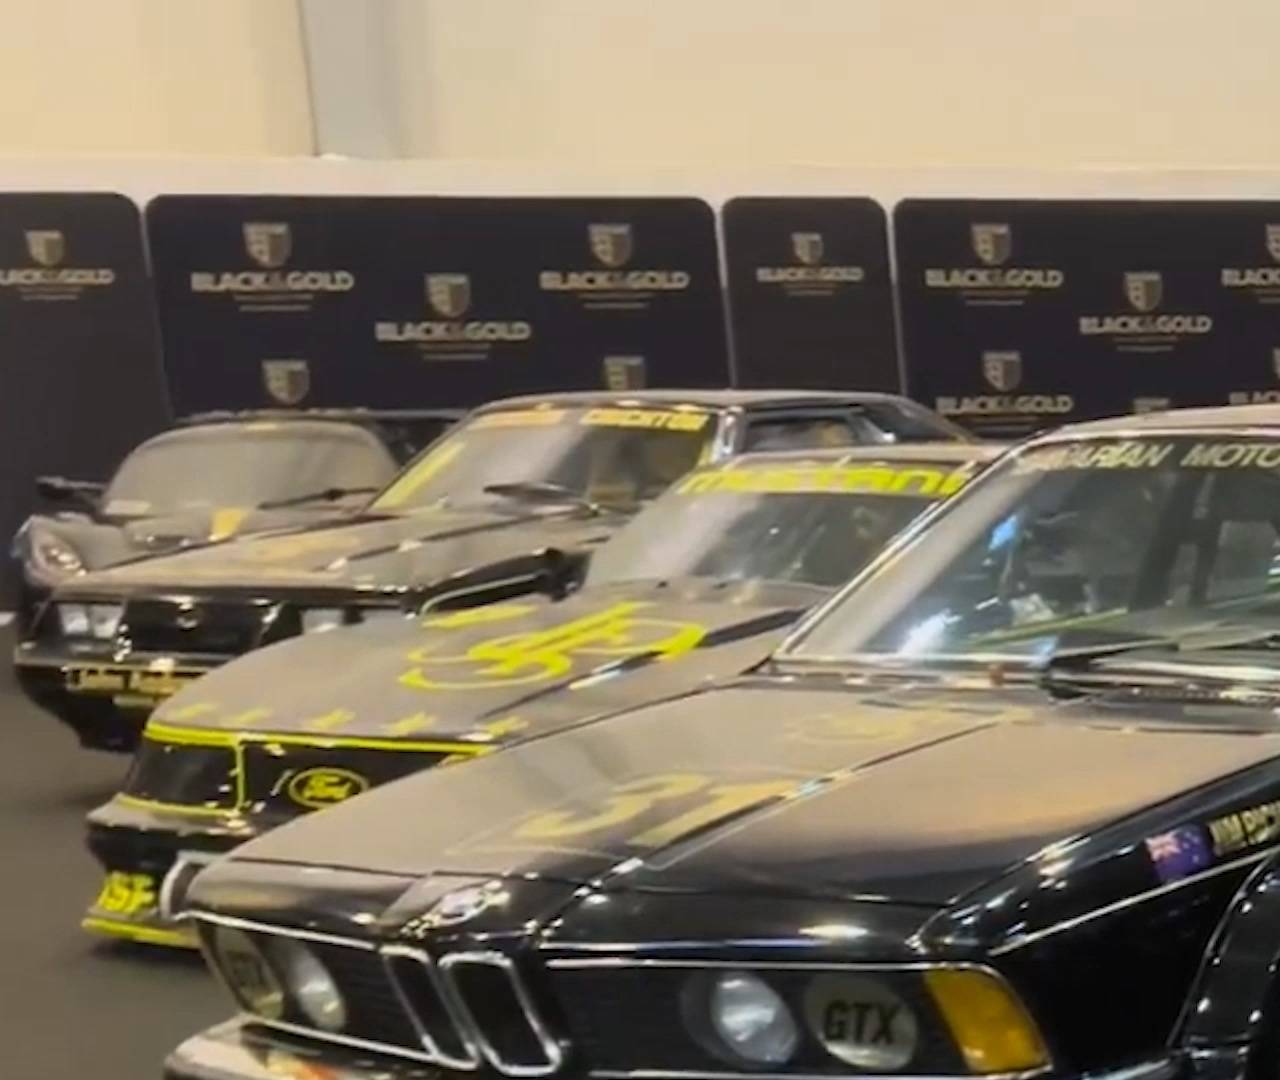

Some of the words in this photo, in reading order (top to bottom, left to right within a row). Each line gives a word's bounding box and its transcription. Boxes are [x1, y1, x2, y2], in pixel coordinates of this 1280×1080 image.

[190, 271, 355, 292] BLACK&GOLD
[538, 271, 690, 289] BLACK&GOLD
[925, 268, 1064, 288] BLACK&GOLD
[375, 321, 532, 343] BLACK&GOLD
[1079, 315, 1213, 335] BLACK&GOLD
[823, 1000, 898, 1046] GTX
